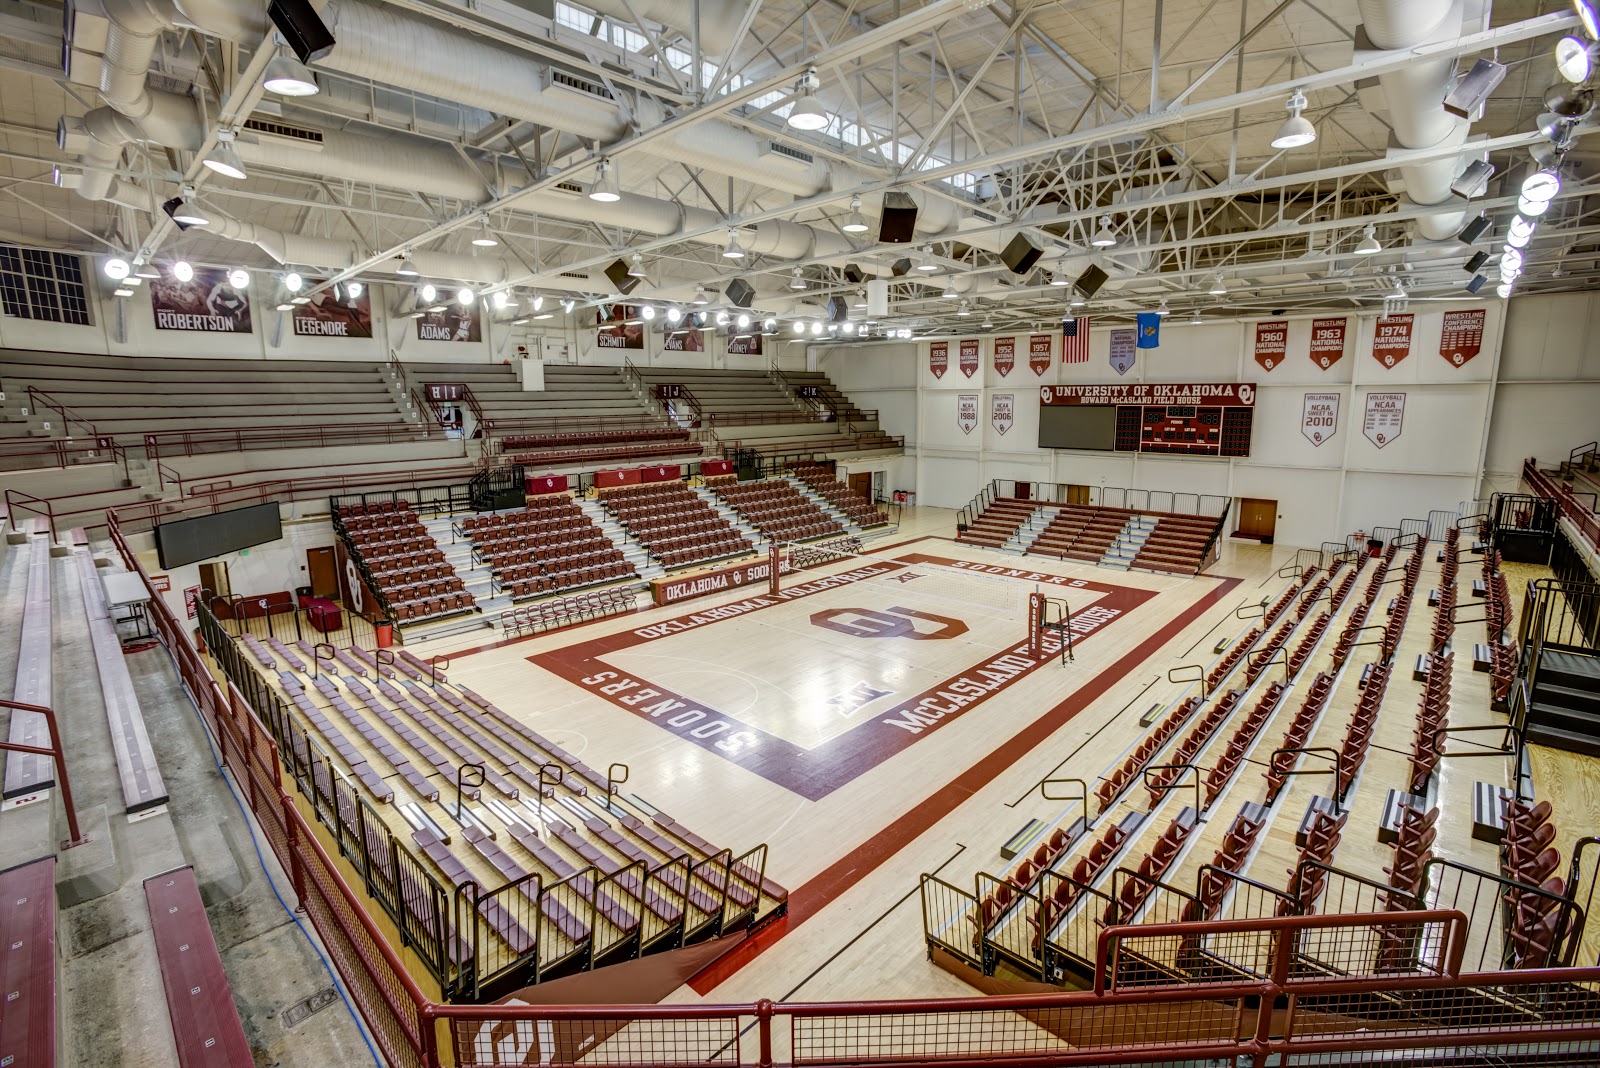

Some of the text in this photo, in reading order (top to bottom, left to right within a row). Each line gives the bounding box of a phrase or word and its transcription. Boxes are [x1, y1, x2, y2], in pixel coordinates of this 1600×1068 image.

[1445, 312, 1484, 320] WRESTLING
[157, 312, 234, 331] ROBERTSON
[296, 320, 348, 336] LEGENDRE
[420, 321, 450, 340] ADAMS
[1380, 326, 1407, 336] 1974
[1260, 332, 1283, 342] 1960
[1316, 329, 1341, 339] 1963
[599, 335, 627, 348] SCHMITT
[997, 346, 1012, 354] 1952
[1033, 344, 1049, 352] 1957
[432, 387, 456, 399] H I
[673, 386, 679, 396] J
[811, 387, 817, 396] K
[1056, 385, 1234, 397] UNIVERSITY OF OKLAHOMA
[1177, 397, 1201, 405] HOUSE
[960, 412, 975, 420] 1988
[994, 412, 1012, 420] 2006
[1306, 417, 1333, 427] 2010
[951, 560, 1088, 588] SOONERS
[666, 574, 729, 601] OKLAHOMA
[633, 564, 883, 640] OKLAHOMA VOLLEYBALL
[581, 671, 757, 756] SOONERS
